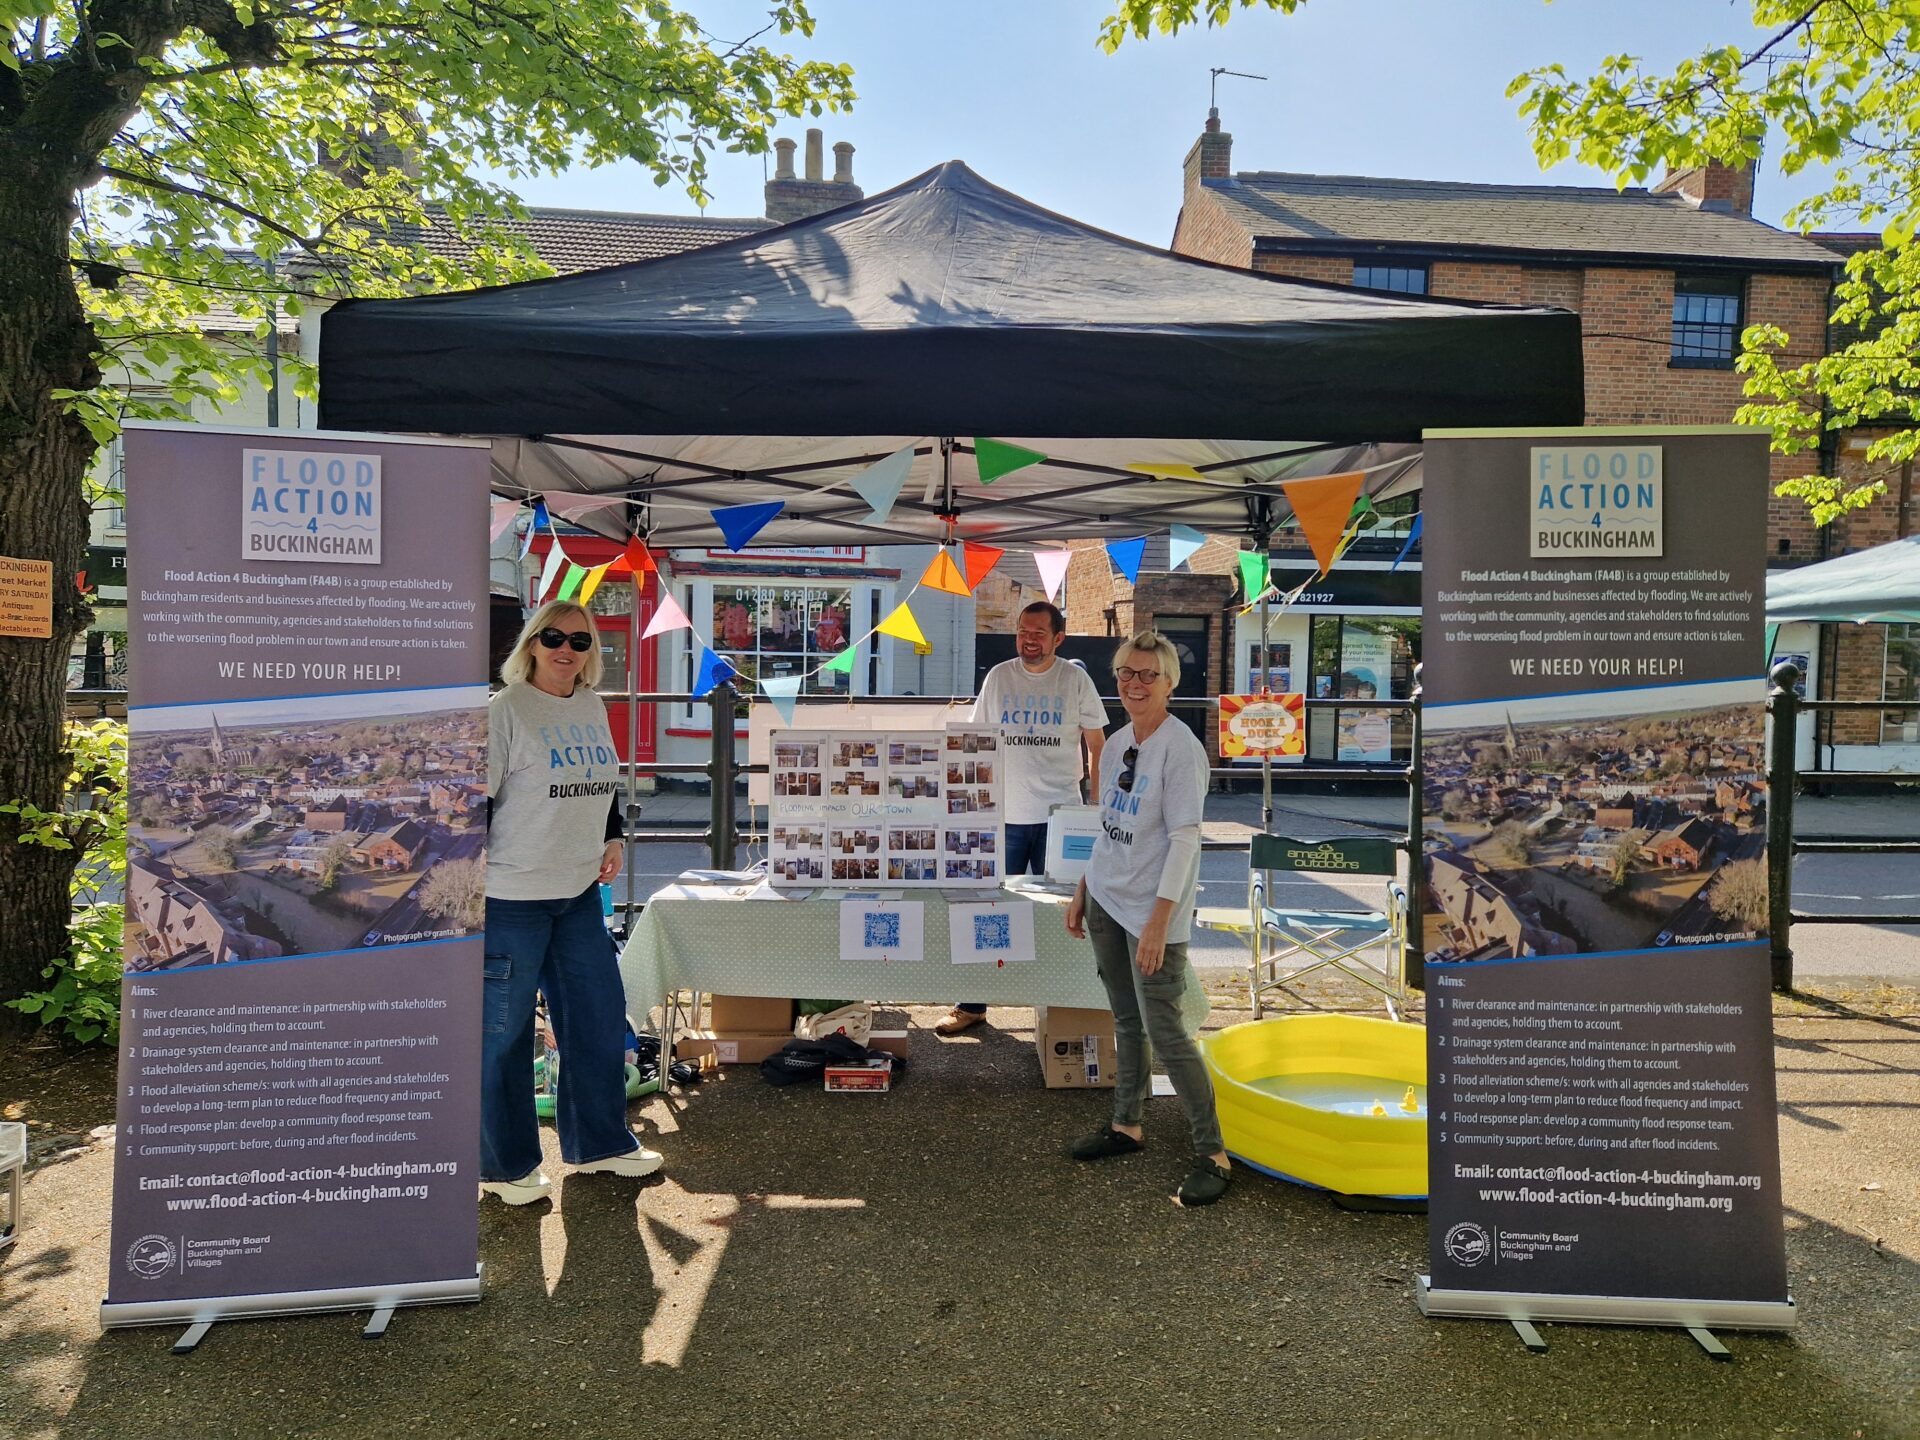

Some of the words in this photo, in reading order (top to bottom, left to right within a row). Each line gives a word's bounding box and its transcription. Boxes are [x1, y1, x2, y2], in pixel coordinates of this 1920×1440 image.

[252, 456, 374, 487] FLOOD
[1540, 453, 1656, 480] FLOOD
[251, 487, 372, 516] ACTION
[1538, 484, 1654, 509] ACTION
[307, 518, 318, 533] 4
[1591, 512, 1602, 528] 4
[251, 534, 373, 555] BUCKINGHAM
[1538, 531, 1655, 548] BUCKINGHAM
[18, 578, 46, 587] Market
[164, 570, 194, 581] Flood
[196, 571, 230, 582] Action
[232, 573, 240, 582] 4
[242, 572, 306, 586] Buckingham
[309, 575, 341, 587] (FA4B)
[361, 579, 387, 589] group
[389, 578, 440, 589] established
[442, 579, 452, 592] by
[11, 590, 48, 599] SATURDAY
[141, 590, 198, 603] Buckingham
[200, 592, 243, 603] residents
[245, 593, 263, 604] and
[266, 593, 314, 605] businesses
[316, 595, 353, 606] affected
[355, 596, 366, 609] by
[368, 596, 408, 610] flooding.
[409, 598, 424, 608] We
[441, 600, 475, 612] actively
[736, 588, 775, 601] 01280
[1269, 594, 1294, 602] 0128
[1300, 594, 1334, 602] 821927
[2, 601, 34, 610] Antiques
[142, 610, 179, 624] working
[182, 612, 204, 622] with
[206, 612, 222, 622] the
[224, 614, 280, 626] community,
[282, 615, 322, 627] agencies
[323, 615, 341, 626] and
[343, 616, 400, 627] stakeholders
[402, 619, 411, 627] to
[413, 617, 431, 628] find
[433, 618, 473, 629] solutions
[147, 632, 156, 641] to
[158, 631, 174, 642] the
[176, 633, 226, 646] worsening
[229, 632, 253, 644] flood
[256, 634, 294, 646] problem
[296, 634, 305, 644] in
[324, 636, 348, 646] town
[350, 636, 367, 646] and
[401, 638, 429, 647] action
[431, 638, 438, 648] is
[440, 638, 467, 648] taken.
[218, 661, 245, 678] WE
[253, 662, 295, 678] NEED
[302, 663, 346, 679] YOUR
[353, 664, 400, 680] HELP!
[1510, 659, 1534, 675] WE
[1541, 658, 1582, 674] NEED
[1588, 658, 1630, 675] YOUR
[1637, 658, 1682, 674] HELP!
[1002, 695, 1063, 710] FLOOD
[1001, 710, 1062, 725] ACTION
[1241, 717, 1275, 728] HOOK
[1278, 717, 1286, 727] A
[1027, 726, 1033, 735] 4
[1248, 728, 1281, 738] DUCK
[551, 746, 618, 768] ACTION
[586, 768, 592, 780] 4
[549, 782, 616, 798] BUCKINGHAM
[780, 804, 814, 812] FLOODING
[852, 803, 878, 815] OUR
[886, 805, 912, 814] TOWN
[1288, 850, 1343, 862] amazing
[1295, 859, 1360, 869] outdoors
[383, 931, 422, 941] Photograph
[1674, 933, 1714, 944] Photograph
[1437, 975, 1465, 986] Aims:
[130, 985, 157, 995] Aims:
[1438, 998, 1443, 1008] 1
[1452, 998, 1474, 1009] River
[1476, 999, 1516, 1009] clearance
[1518, 999, 1534, 1010] and
[1536, 1000, 1597, 1011] maintenance:
[1599, 1001, 1608, 1012] in
[1610, 1002, 1661, 1015] partnership
[1662, 1002, 1683, 1013] with
[1685, 1002, 1742, 1014] stakeholders
[1452, 1016, 1469, 1026] and
[1471, 1016, 1510, 1029] agencies,
[1512, 1016, 1546, 1030] holding
[1548, 1017, 1571, 1028] them
[1574, 1019, 1583, 1028] to
[1585, 1020, 1622, 1030] account.
[139, 1174, 183, 1190] Email:
[186, 1161, 456, 1186] contact@flood-action-4-buckingham.org
[1454, 1164, 1494, 1178] Email:
[1496, 1166, 1760, 1190] contact@flood-action-4-buckingham.org
[166, 1186, 428, 1209] www.flood-action-4-buckingham.org
[1479, 1189, 1732, 1211] www.flood-action-4-buckingham.org
[187, 1237, 240, 1247] Community
[243, 1235, 270, 1244] Board
[1500, 1231, 1550, 1242] Community
[1552, 1233, 1578, 1241] Board
[187, 1247, 242, 1257] Buckingham
[244, 1245, 261, 1254] and
[1500, 1241, 1552, 1251] Buckingham
[1500, 1250, 1533, 1260] Villages
[186, 1258, 221, 1267] Villages
